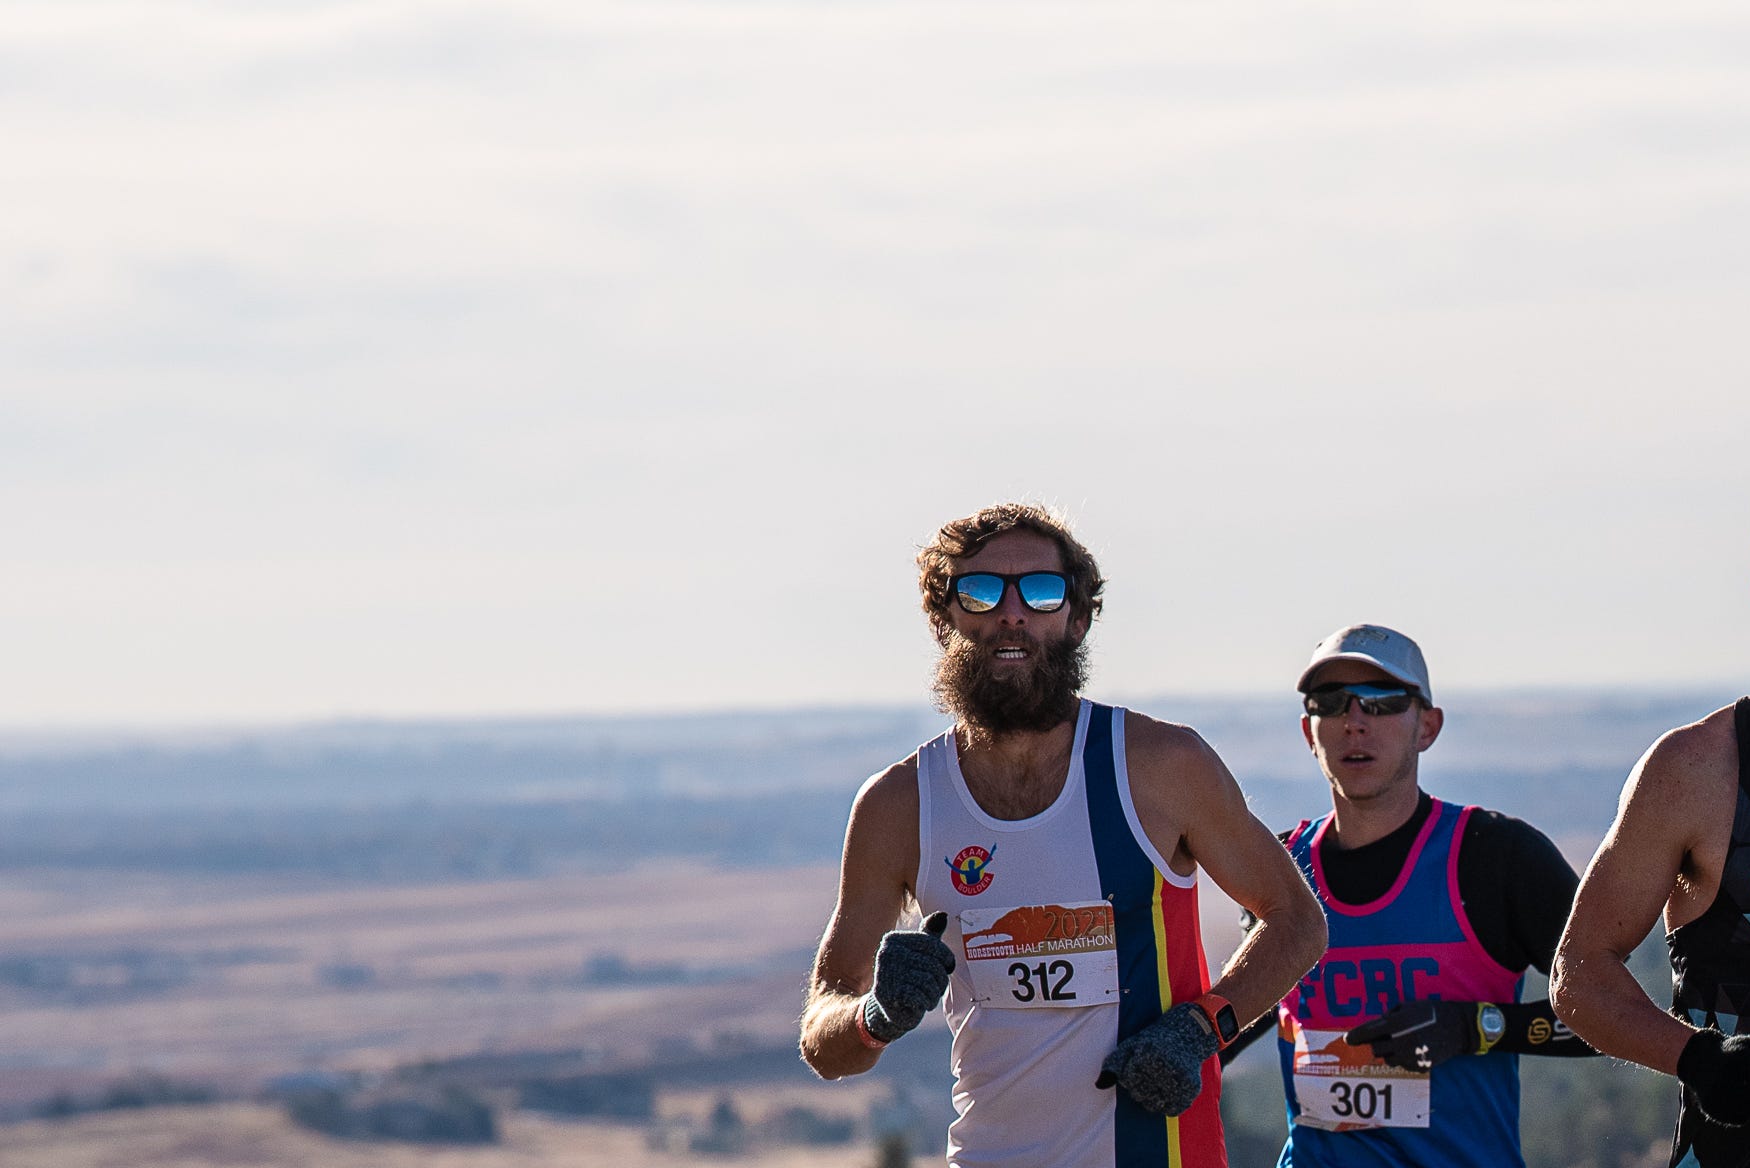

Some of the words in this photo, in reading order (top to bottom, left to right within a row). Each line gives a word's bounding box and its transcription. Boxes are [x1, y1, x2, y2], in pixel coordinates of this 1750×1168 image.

[957, 847, 984, 862] TEAM
[958, 876, 991, 894] BOULDER
[1044, 907, 1110, 940] 2021
[966, 944, 1015, 959] HORSETOOTH
[1016, 941, 1045, 954] HALF
[1047, 934, 1114, 951] MARATHON
[1008, 960, 1077, 1002] 312
[1330, 1081, 1393, 1120] 301
